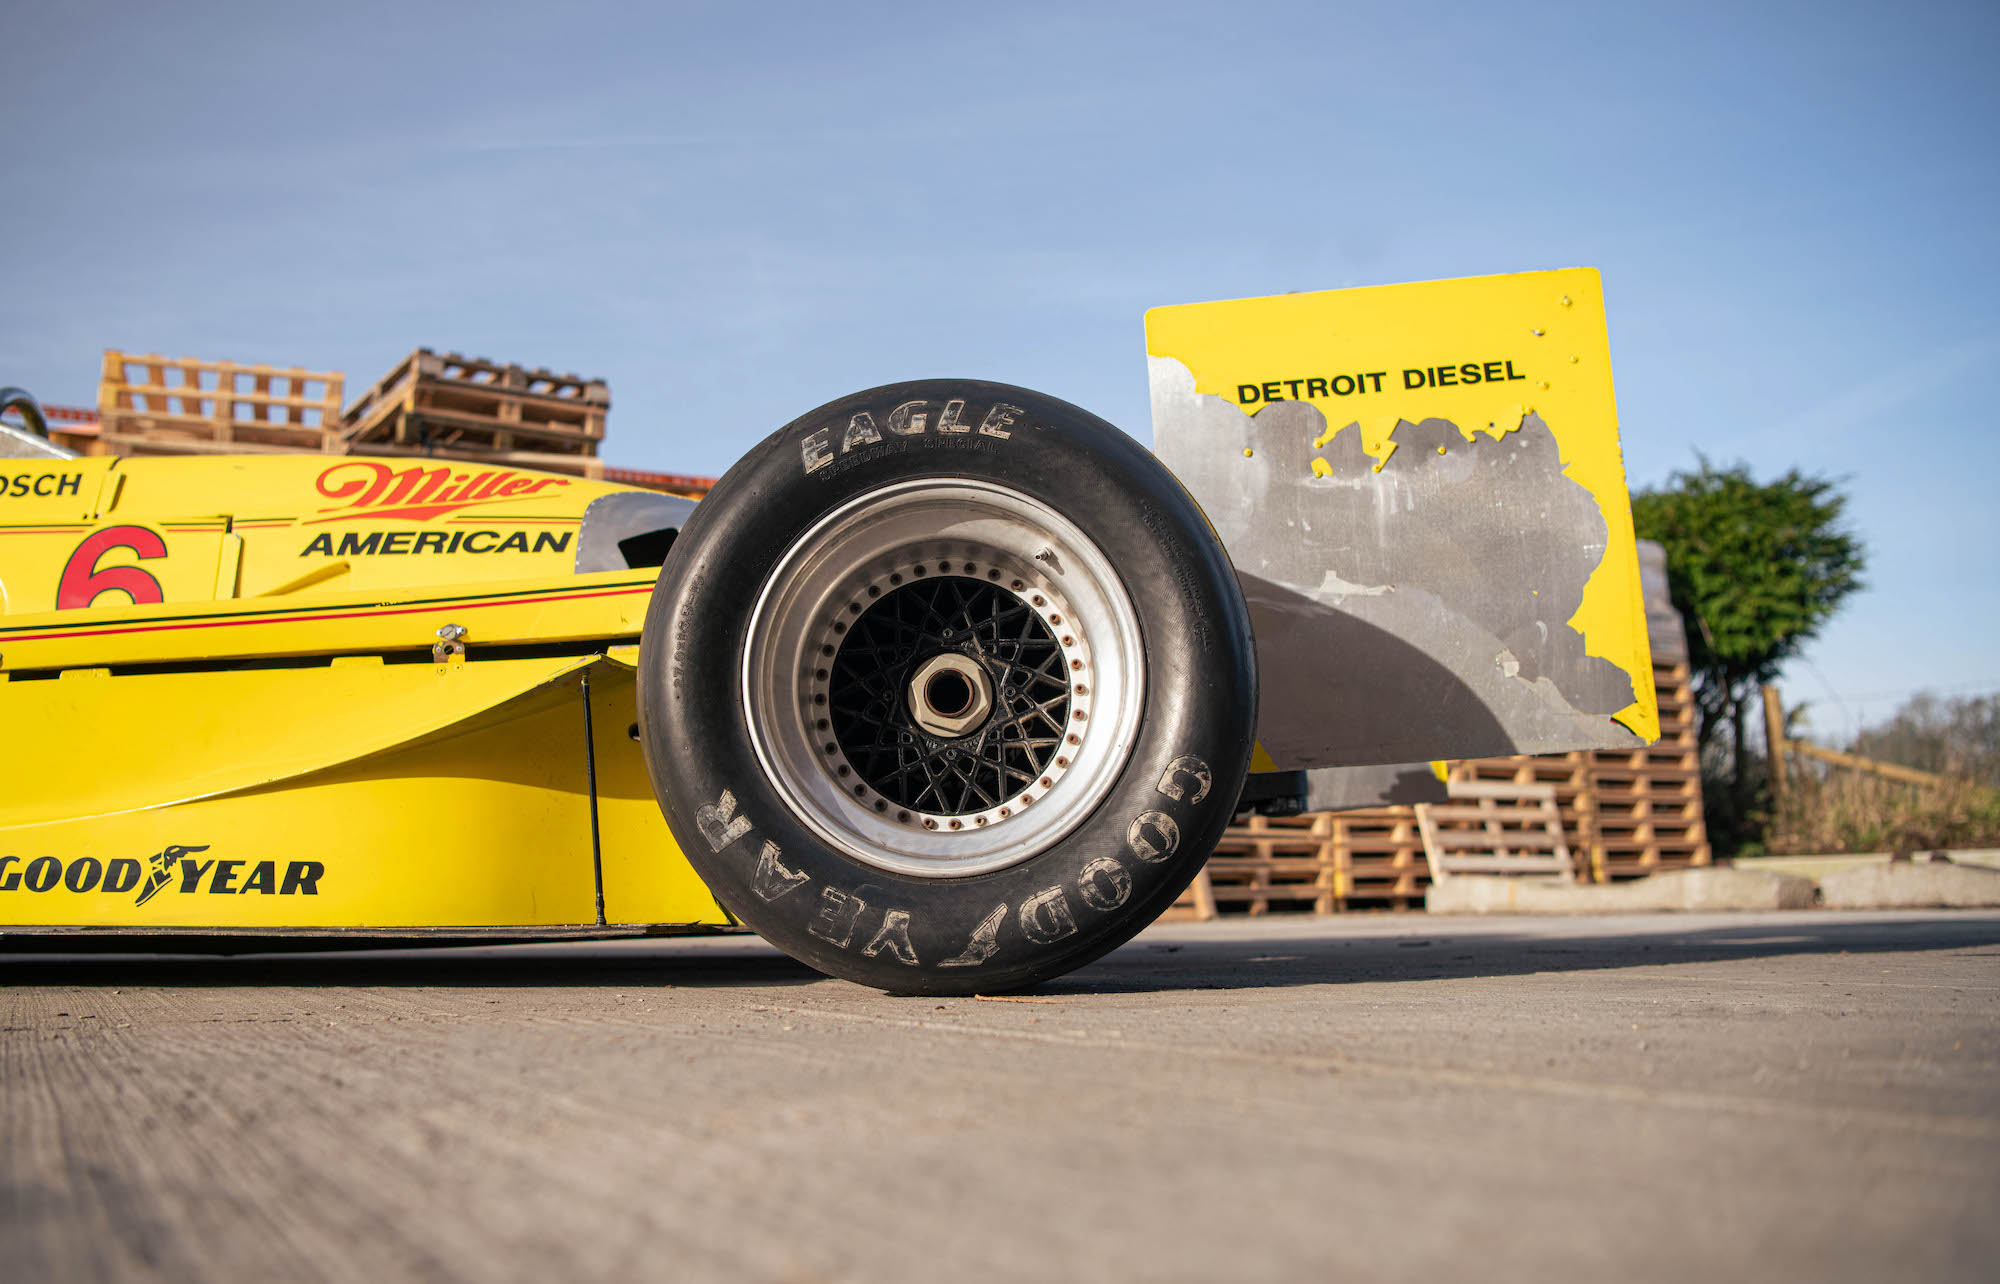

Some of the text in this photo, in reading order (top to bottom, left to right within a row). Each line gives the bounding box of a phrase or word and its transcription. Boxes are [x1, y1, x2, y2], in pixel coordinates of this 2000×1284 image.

[1237, 360, 1526, 404] DETROIT DIESEL
[800, 399, 1025, 475] EAGLE
[818, 438, 998, 481] SPEEDWAY SPECIAL
[316, 462, 572, 514] Miller
[56, 524, 168, 611] 6
[299, 531, 574, 557] AMERICAN
